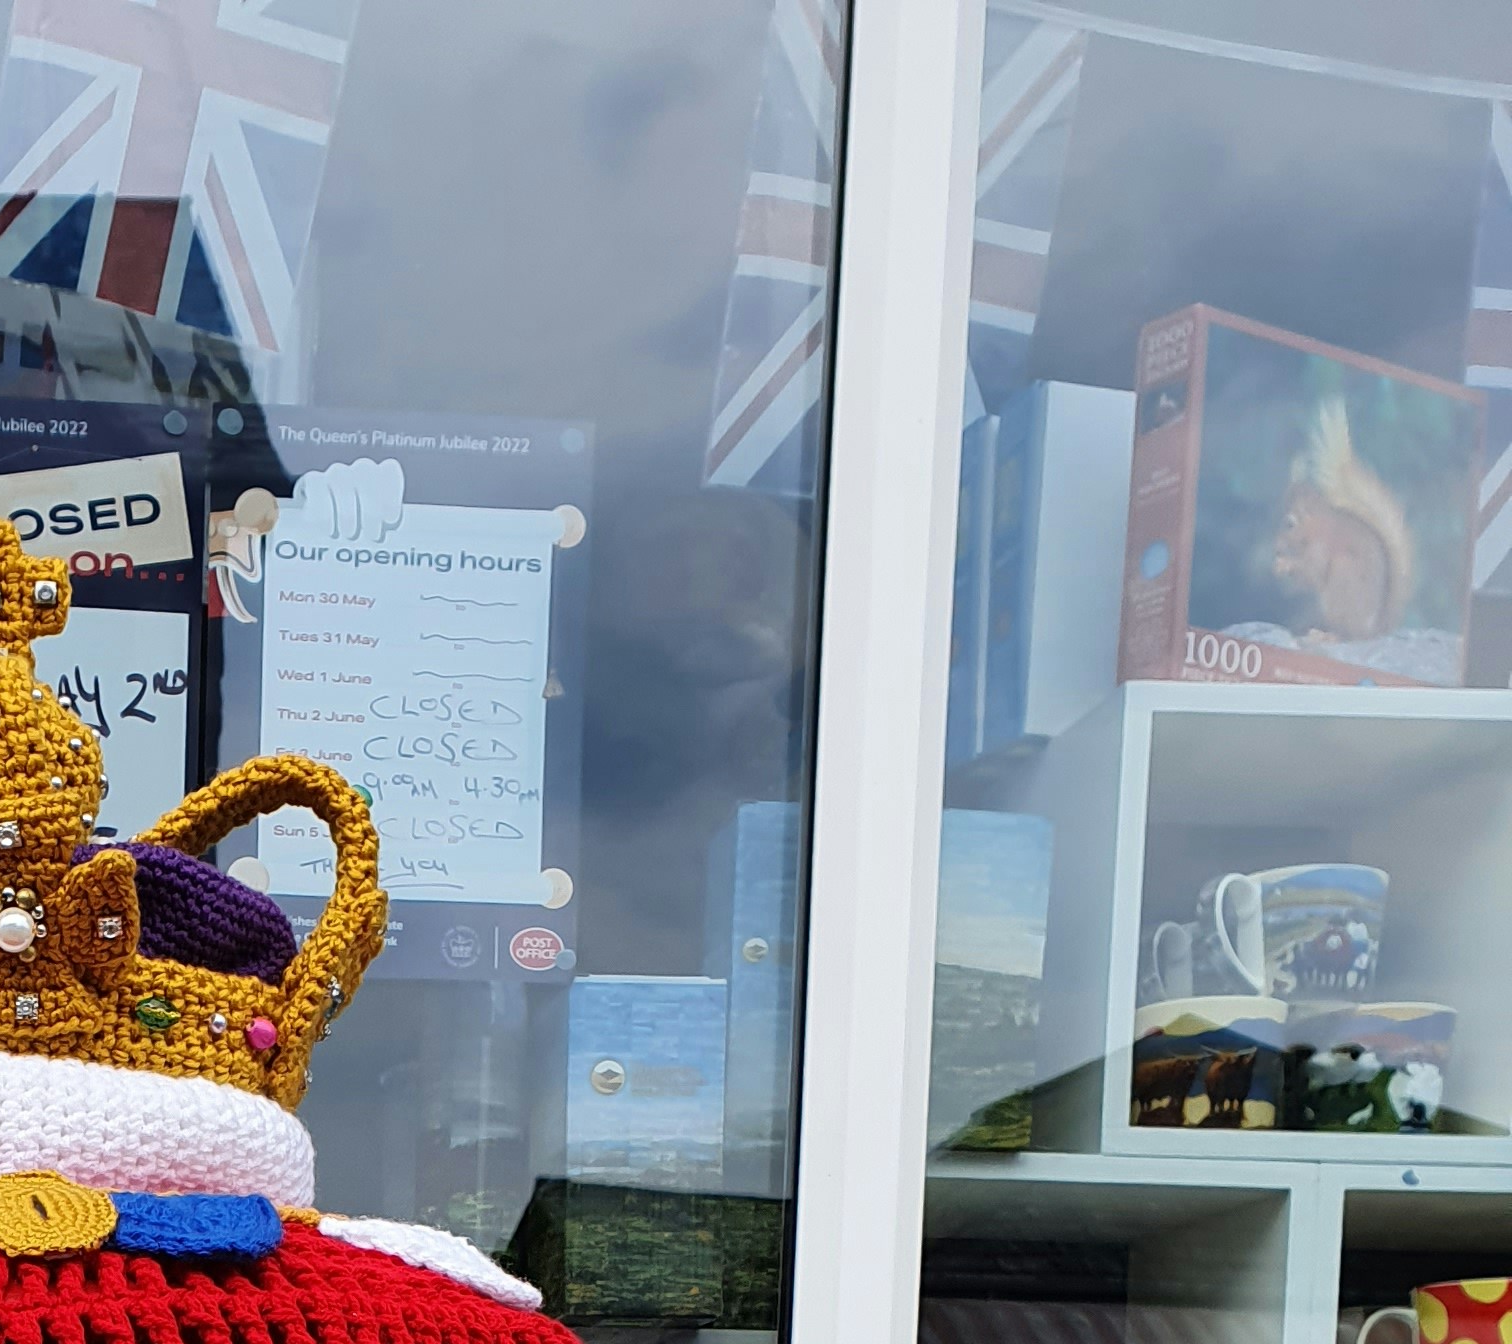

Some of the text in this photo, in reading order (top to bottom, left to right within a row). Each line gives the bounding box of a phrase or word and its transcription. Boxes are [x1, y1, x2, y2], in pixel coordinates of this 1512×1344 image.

[49, 419, 88, 436] 2022
[279, 425, 530, 453] The Queen's Platinum Jubilee 2022
[275, 540, 542, 573] Our opening hours
[279, 590, 376, 609] Mon 30 May
[279, 629, 380, 649] Tues 31 May
[1185, 633, 1262, 680] 1000
[277, 669, 372, 686] Wed 1 June
[276, 708, 365, 726] Thu 2 June
[369, 693, 522, 726] CLOSED
[312, 749, 353, 762] June
[363, 732, 518, 763] CLOSED
[273, 825, 305, 838] Sun
[309, 826, 319, 838] 5
[377, 814, 524, 841] CLOSED
[523, 936, 553, 948] POST
[515, 947, 557, 960] OFFICE
